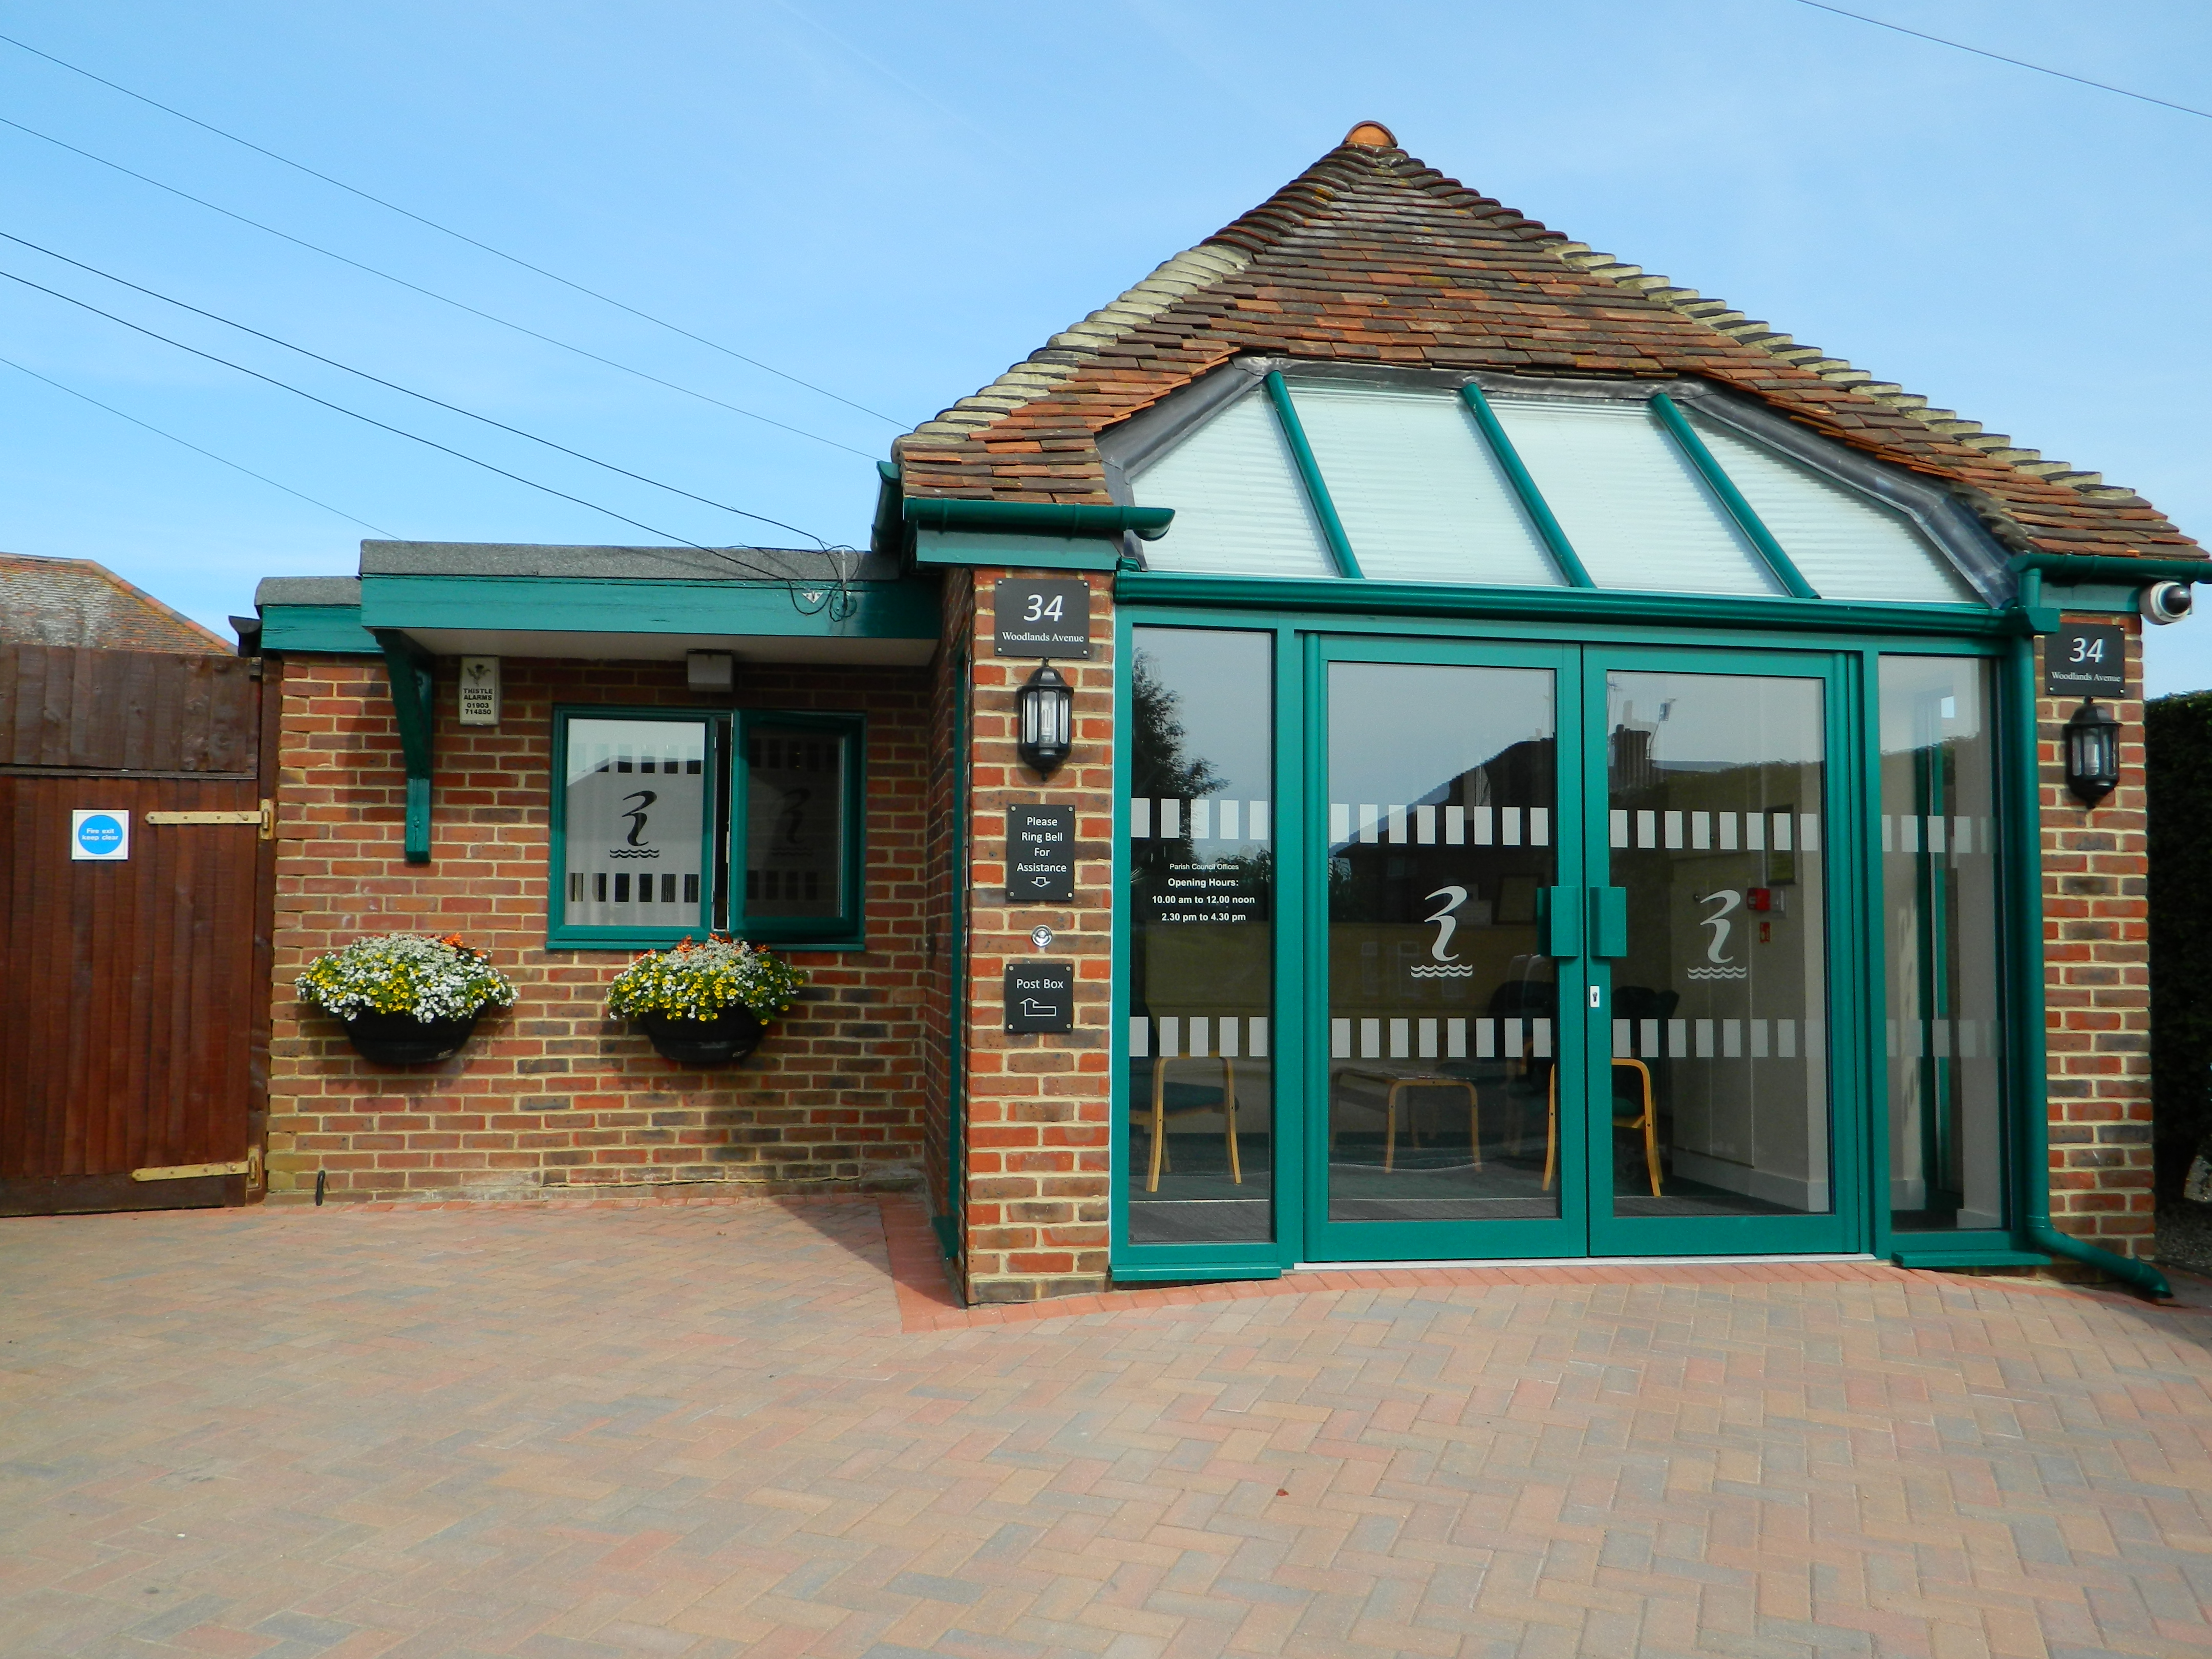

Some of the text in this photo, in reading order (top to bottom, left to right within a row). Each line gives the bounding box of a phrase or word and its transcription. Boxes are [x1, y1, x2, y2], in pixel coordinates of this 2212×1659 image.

[1024, 594, 1063, 622] 34
[1002, 631, 1084, 642] Woodlands Avenue
[2069, 636, 2103, 663] 34
[2051, 671, 2121, 682] Woodlands Avenue
[1027, 817, 1058, 826] Please
[1022, 832, 1063, 843] Ring Bell
[1034, 847, 1050, 857] For
[1016, 863, 1067, 873] Assistance
[1167, 878, 1239, 888] Opening Hours:
[1152, 896, 1176, 904] 10.00
[1206, 896, 1229, 904] 12.00
[1161, 913, 1180, 921] 2.30
[1210, 913, 1229, 921] 4.30
[1016, 979, 1064, 989] Post Box
